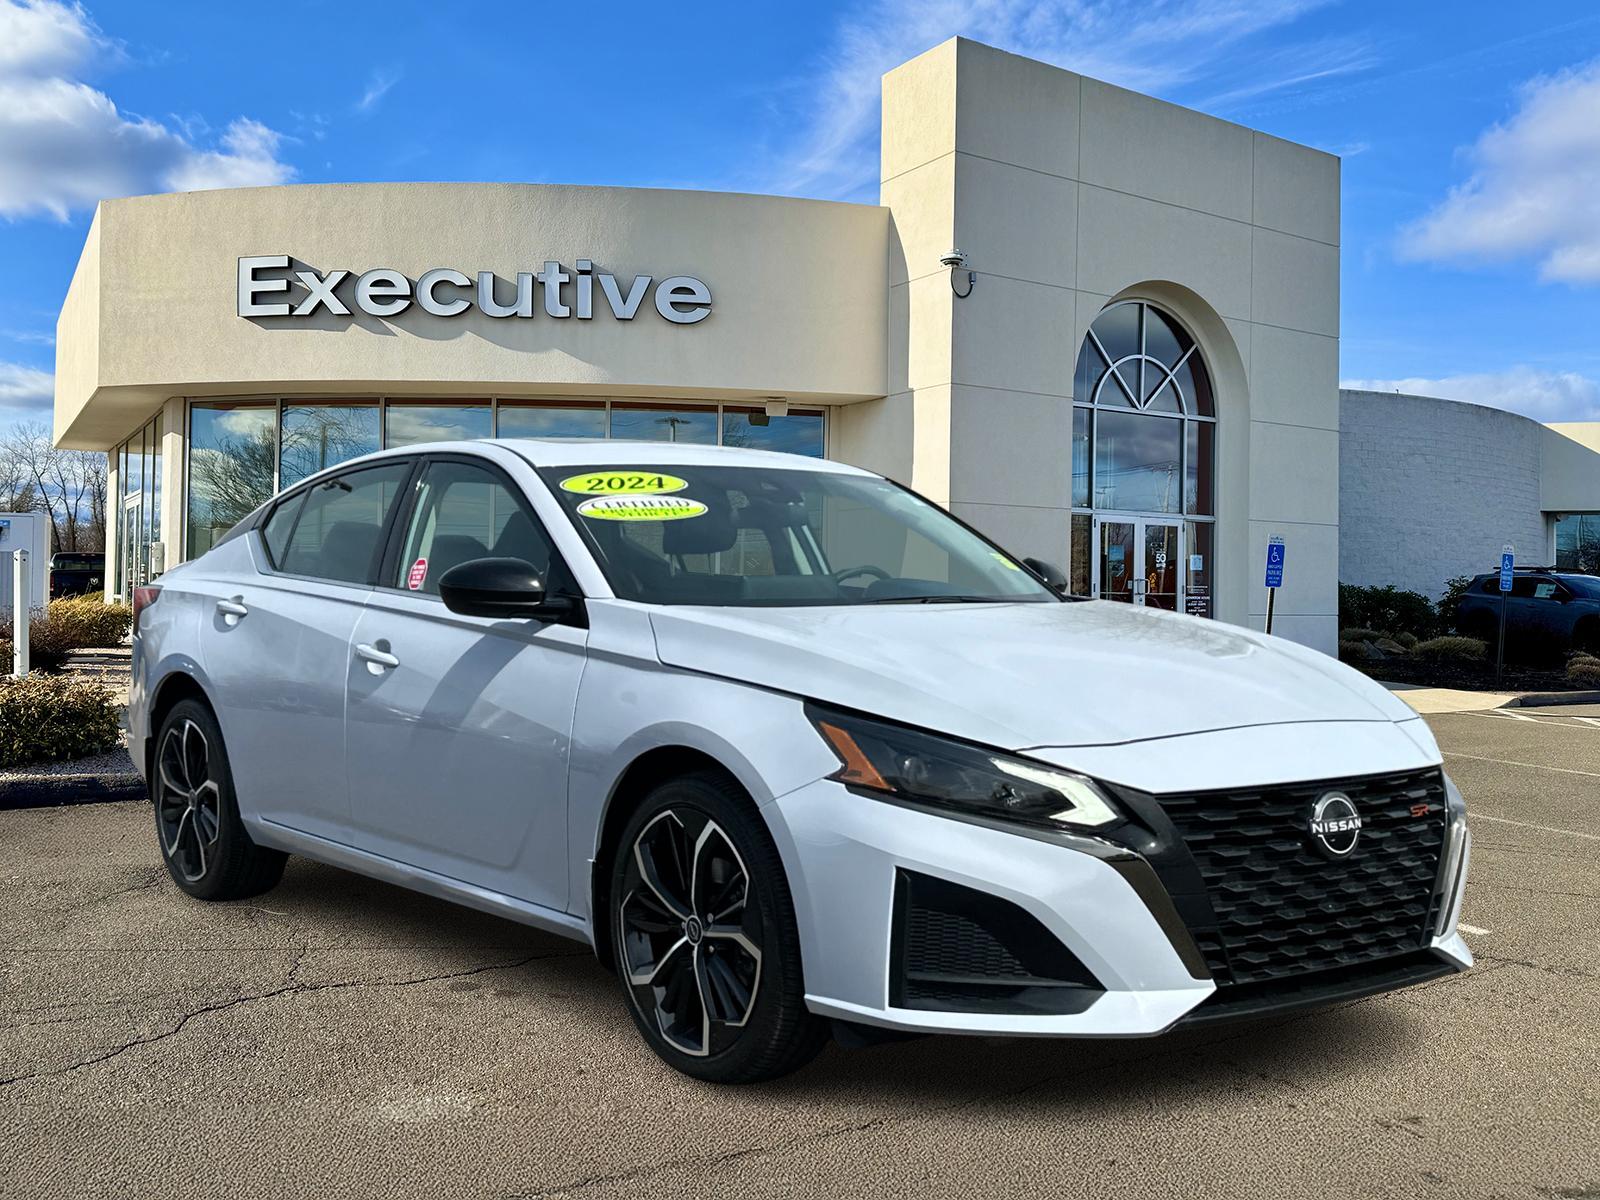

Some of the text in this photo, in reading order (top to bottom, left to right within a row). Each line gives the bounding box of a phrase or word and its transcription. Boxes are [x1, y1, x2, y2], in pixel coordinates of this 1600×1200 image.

[237, 254, 713, 325] Executive
[586, 476, 668, 491] 2024
[590, 500, 690, 510] CERTIFIED
[1410, 804, 1429, 817] SR
[1312, 818, 1362, 834] NISSAN
